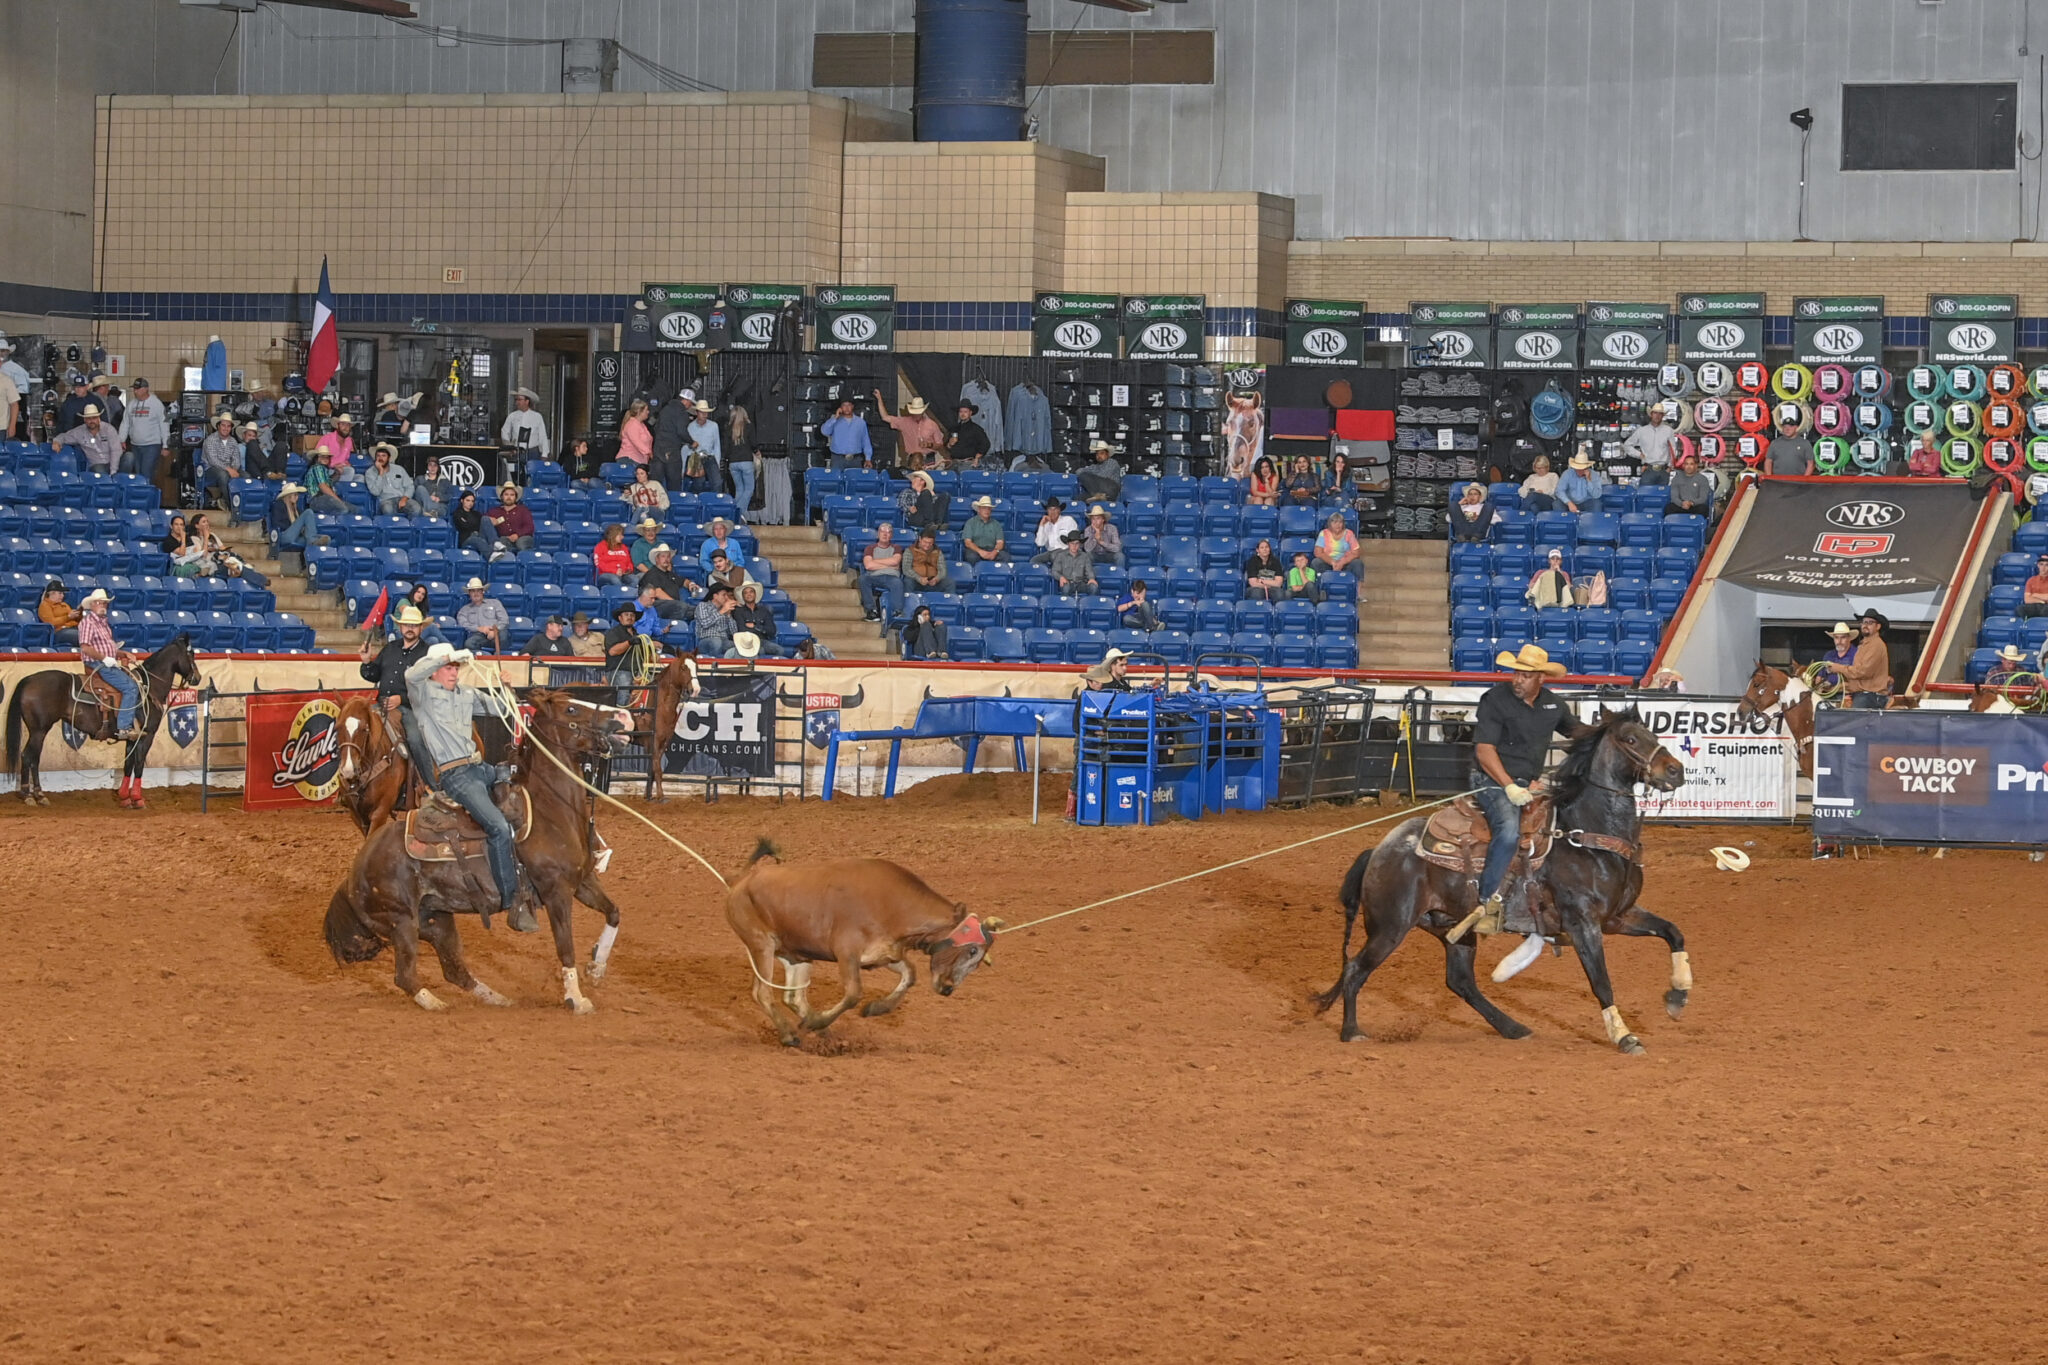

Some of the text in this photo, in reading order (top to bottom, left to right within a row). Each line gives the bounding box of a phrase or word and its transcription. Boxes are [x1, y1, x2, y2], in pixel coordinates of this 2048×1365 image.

[446, 269, 462, 281] EXIT
[650, 288, 715, 302] NRS 800-GO-ROPIN
[732, 288, 800, 303] NRS 800-GO-ROPIN
[821, 290, 890, 304] NRS 800-GO-ROPIN
[1043, 296, 1115, 311] NRS 800-GO-ROPIN
[1128, 300, 1147, 314] NRS
[1293, 303, 1360, 318] NRS 800-GO-ROPIN
[1686, 298, 1759, 313] NRS 800-GO-ROPIN
[1803, 301, 1878, 316] NRS 800-GO-ROPIN
[1937, 299, 2011, 314] NRS 800-GO-ROPIN
[1418, 307, 1435, 322] NRS
[1505, 309, 1522, 323] NRS
[1593, 306, 1664, 321] NRS 800-GO-ROPIN
[667, 315, 696, 337] NRS
[839, 317, 869, 338] NRS
[1062, 324, 1092, 346] NRS
[1149, 326, 1179, 347] NRS
[1310, 332, 1339, 353] NRS
[1705, 325, 1736, 346] NRS
[1822, 328, 1855, 350] NRS
[1956, 327, 1987, 349] NRS
[820, 342, 888, 351] NRSworld.com
[1523, 335, 1553, 356] NRS
[1610, 335, 1640, 356] NRS
[1042, 350, 1112, 359] NRSworld.com
[1130, 352, 1198, 360] NRSworld.com
[1291, 356, 1358, 366] NRSworld.com
[1685, 351, 1757, 359] NRSworld.com
[1801, 355, 1876, 363] NRSworld.com
[1935, 353, 2008, 362] NRSworld.com
[600, 359, 615, 376] NRS
[1503, 360, 1573, 369] NRSworld.com
[1590, 360, 1659, 369] NRSworld.com
[1234, 367, 1254, 385] NRS
[440, 461, 473, 486] NRS
[1835, 503, 1893, 526] NRS
[1829, 538, 1879, 552] HP
[1785, 555, 1844, 564] HORSE
[1756, 573, 1917, 588] All Things Western
[1787, 570, 1825, 579] YOUR
[1828, 572, 1864, 580] BOOT
[169, 690, 196, 703] USTRC
[806, 695, 839, 707] USTRC
[296, 704, 336, 727] GENUINE
[274, 721, 338, 783] Lawle
[664, 743, 761, 755] CHJEANS.COM
[1708, 743, 1784, 758] Equipment
[1685, 767, 1716, 775] tur, TX
[1880, 756, 1977, 775] COWBOY
[308, 781, 339, 798] EQUIN
[1685, 777, 1727, 787] nville, TX
[1899, 776, 1957, 793] TACK
[1152, 787, 1174, 803] efert
